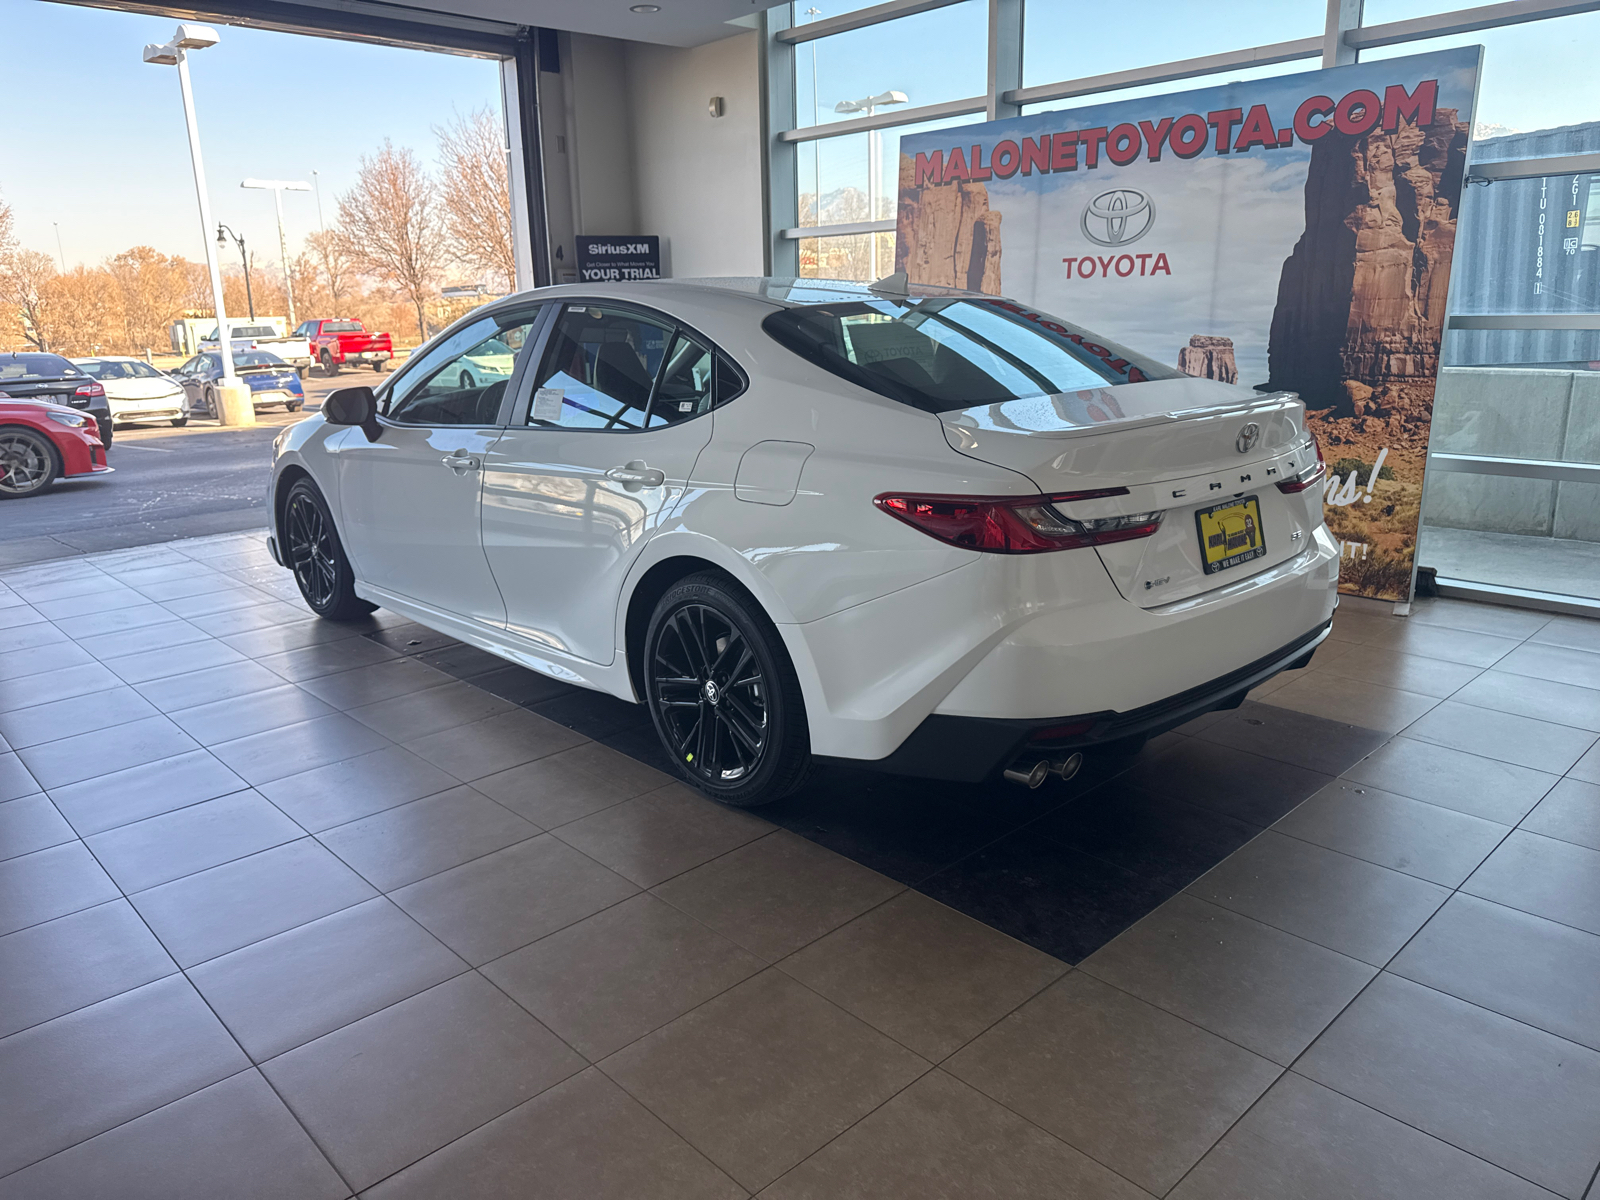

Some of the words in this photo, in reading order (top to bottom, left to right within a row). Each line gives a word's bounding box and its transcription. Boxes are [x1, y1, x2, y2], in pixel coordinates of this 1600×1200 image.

[914, 79, 1439, 187] MALONETOYOTA.COM
[555, 245, 564, 261] 4
[588, 243, 650, 255] SiriusXM
[582, 268, 619, 280] YOUR
[621, 268, 660, 279] TRIAL
[1062, 252, 1172, 279] TOYOTA
[1172, 460, 1296, 499] CAMRY
